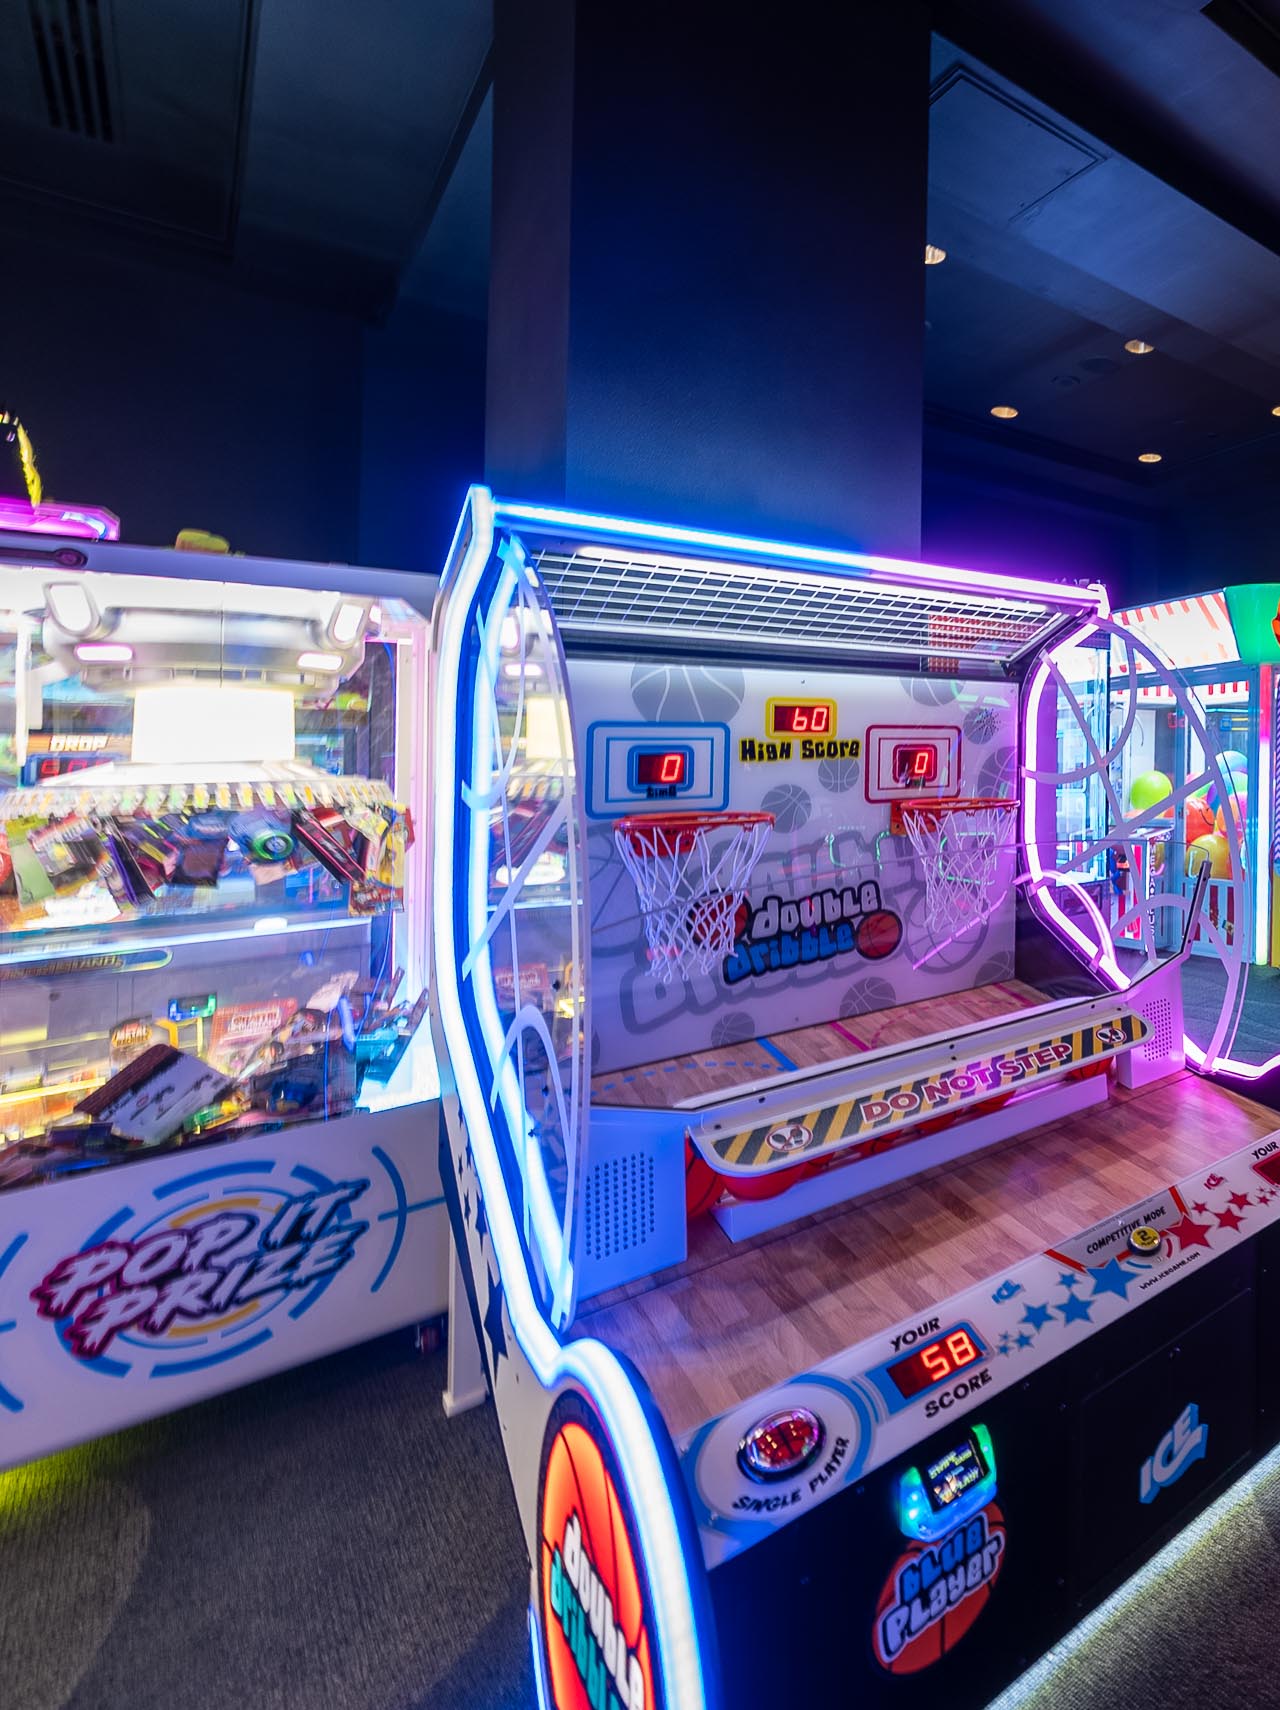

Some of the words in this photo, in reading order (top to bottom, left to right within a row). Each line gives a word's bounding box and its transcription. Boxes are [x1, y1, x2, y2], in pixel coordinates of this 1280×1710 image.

[49, 735, 110, 752] DROP
[661, 755, 682, 783] 0
[913, 752, 929, 774] 0
[860, 1092, 920, 1125] DO
[923, 1066, 995, 1101] NOT
[1000, 1043, 1073, 1078] STEP
[1251, 1140, 1280, 1161] YOUR
[1203, 1172, 1226, 1191] ICE
[32, 1212, 258, 1318] POP
[261, 1179, 371, 1252] IT
[1086, 1218, 1142, 1256] COMPETITIVE
[1142, 1205, 1167, 1225] MODE
[65, 1221, 370, 1358] PRIZE
[991, 1279, 1024, 1305] ICE
[889, 1317, 941, 1353] YOUR
[920, 1330, 978, 1381] 58
[925, 1368, 993, 1419] SCORE
[732, 1488, 803, 1515] SINGLE
[808, 1436, 851, 1495] PLAYER
[1139, 1403, 1209, 1504] ICE
